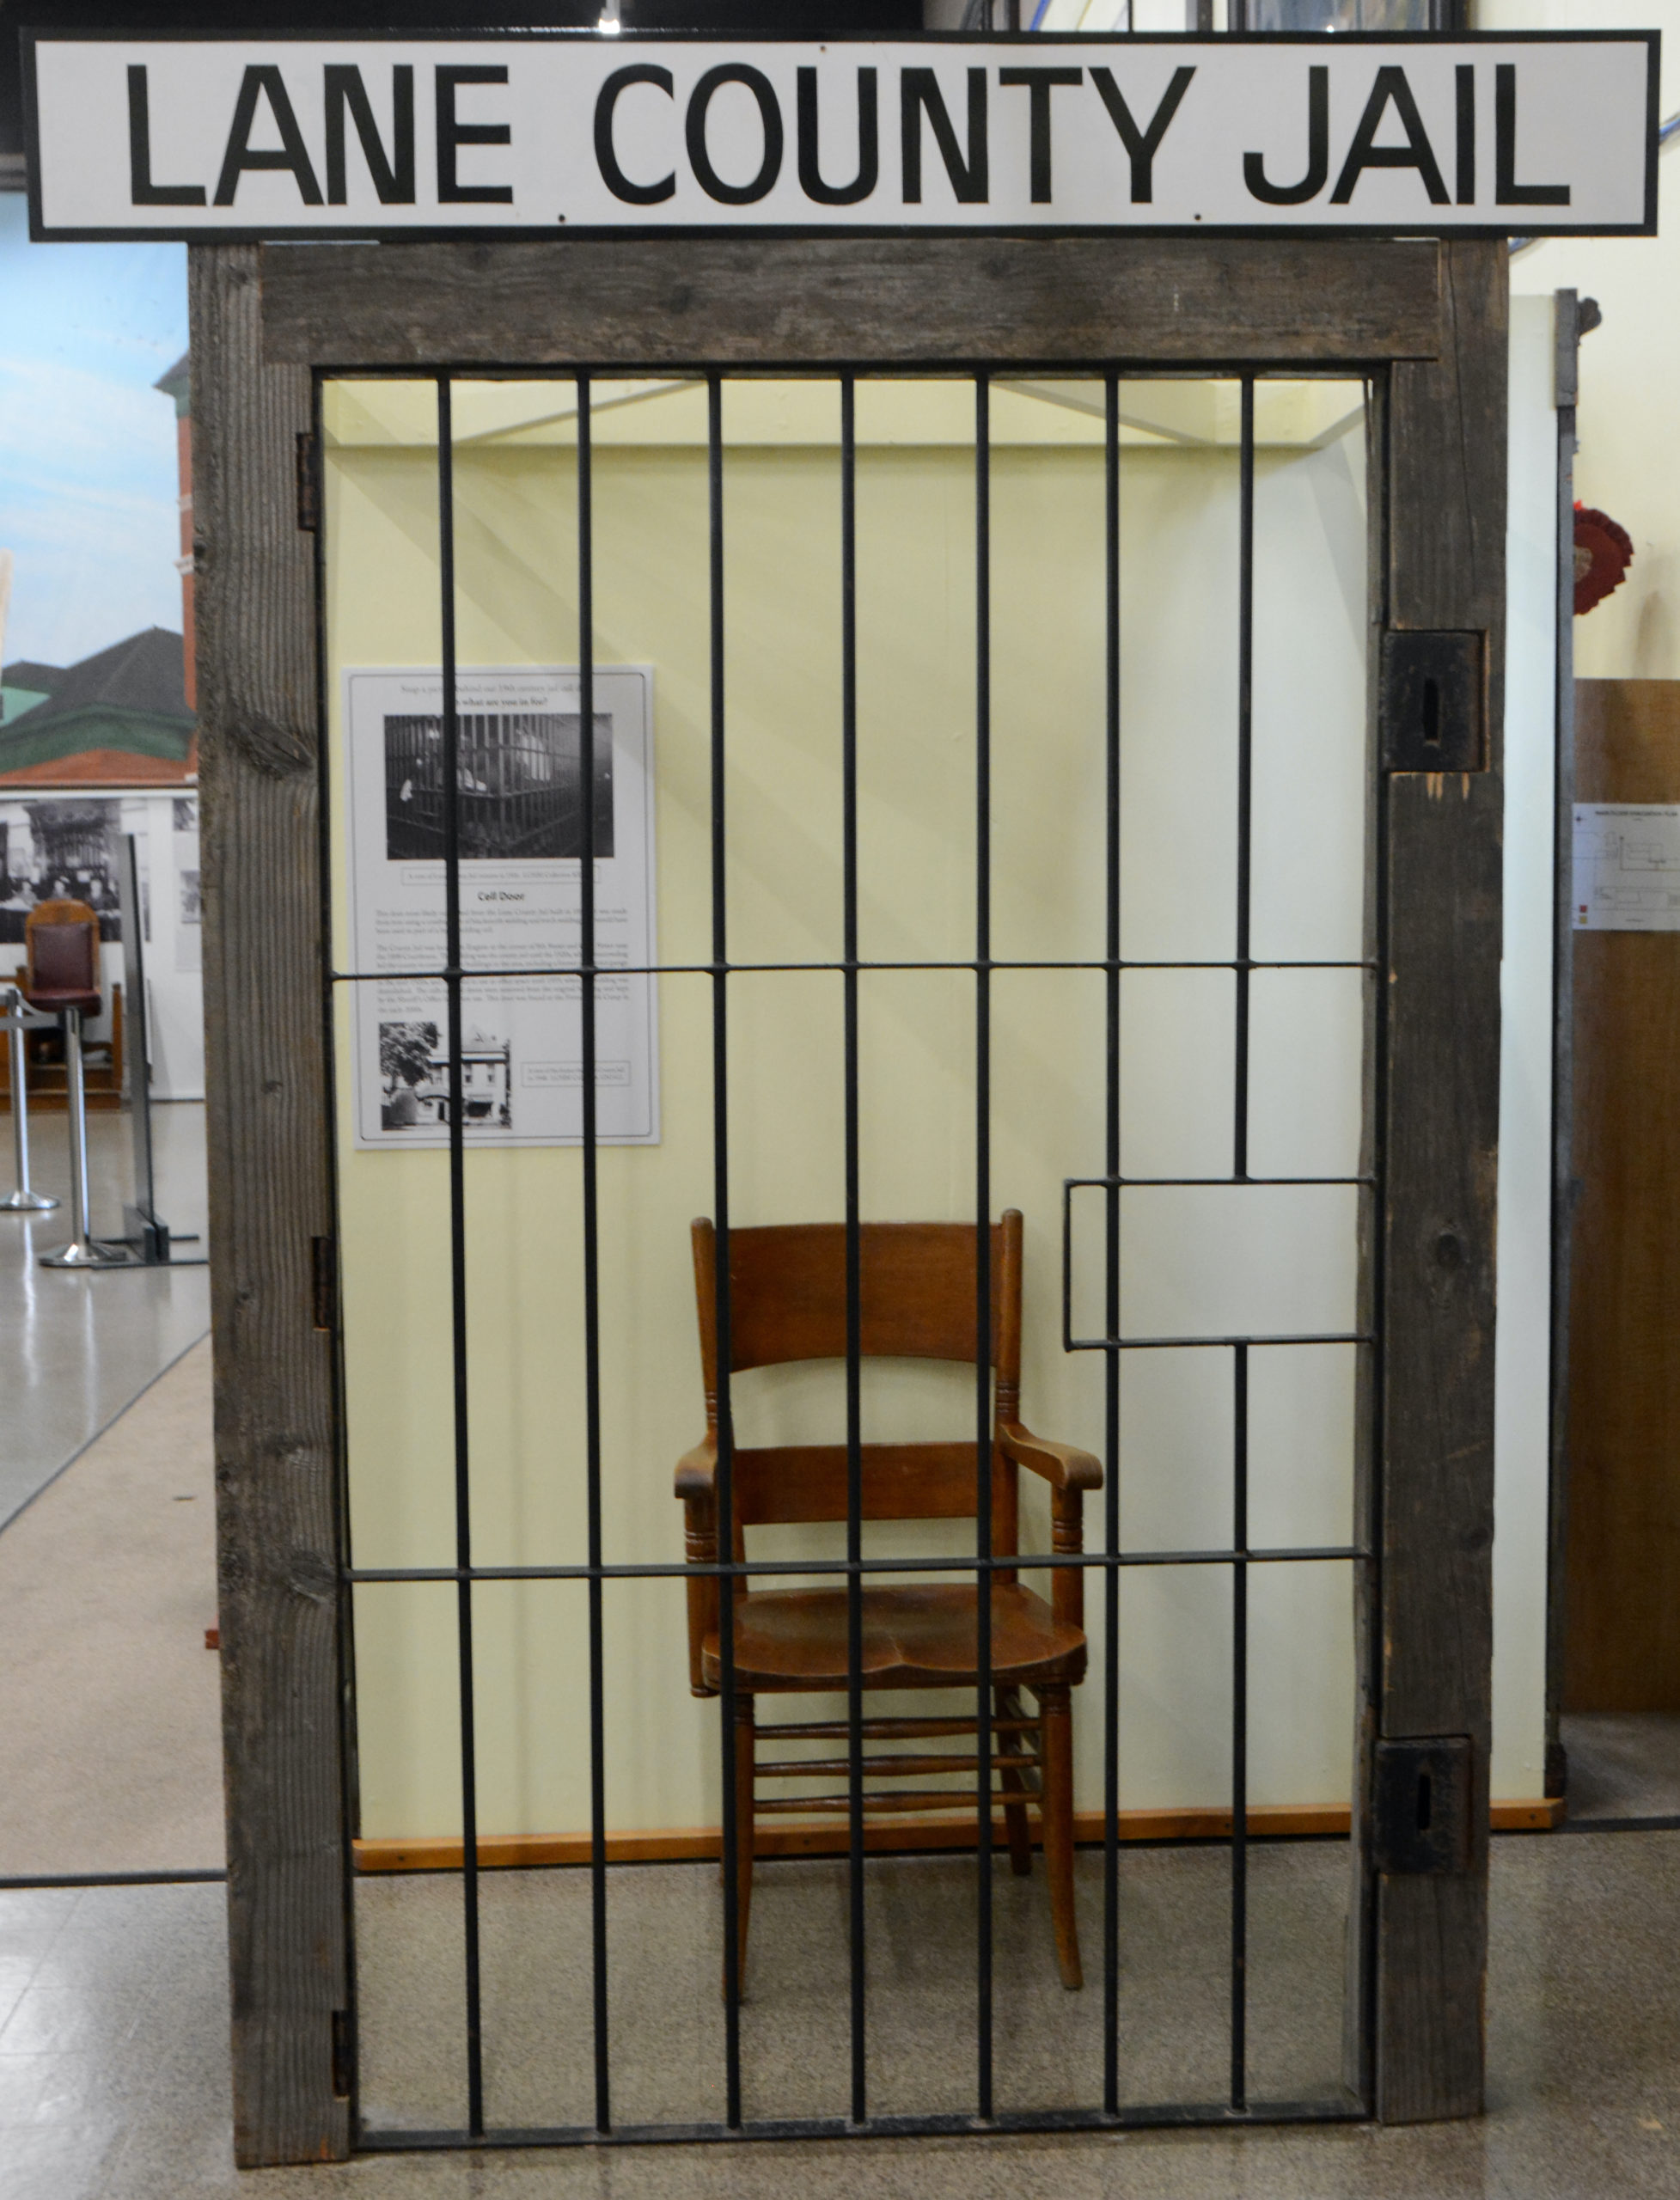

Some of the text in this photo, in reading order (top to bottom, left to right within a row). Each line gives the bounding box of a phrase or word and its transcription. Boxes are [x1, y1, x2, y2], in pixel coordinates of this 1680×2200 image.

[128, 64, 1571, 206] LANE COUNTY JAIL
[477, 891, 525, 901] Cell Door
